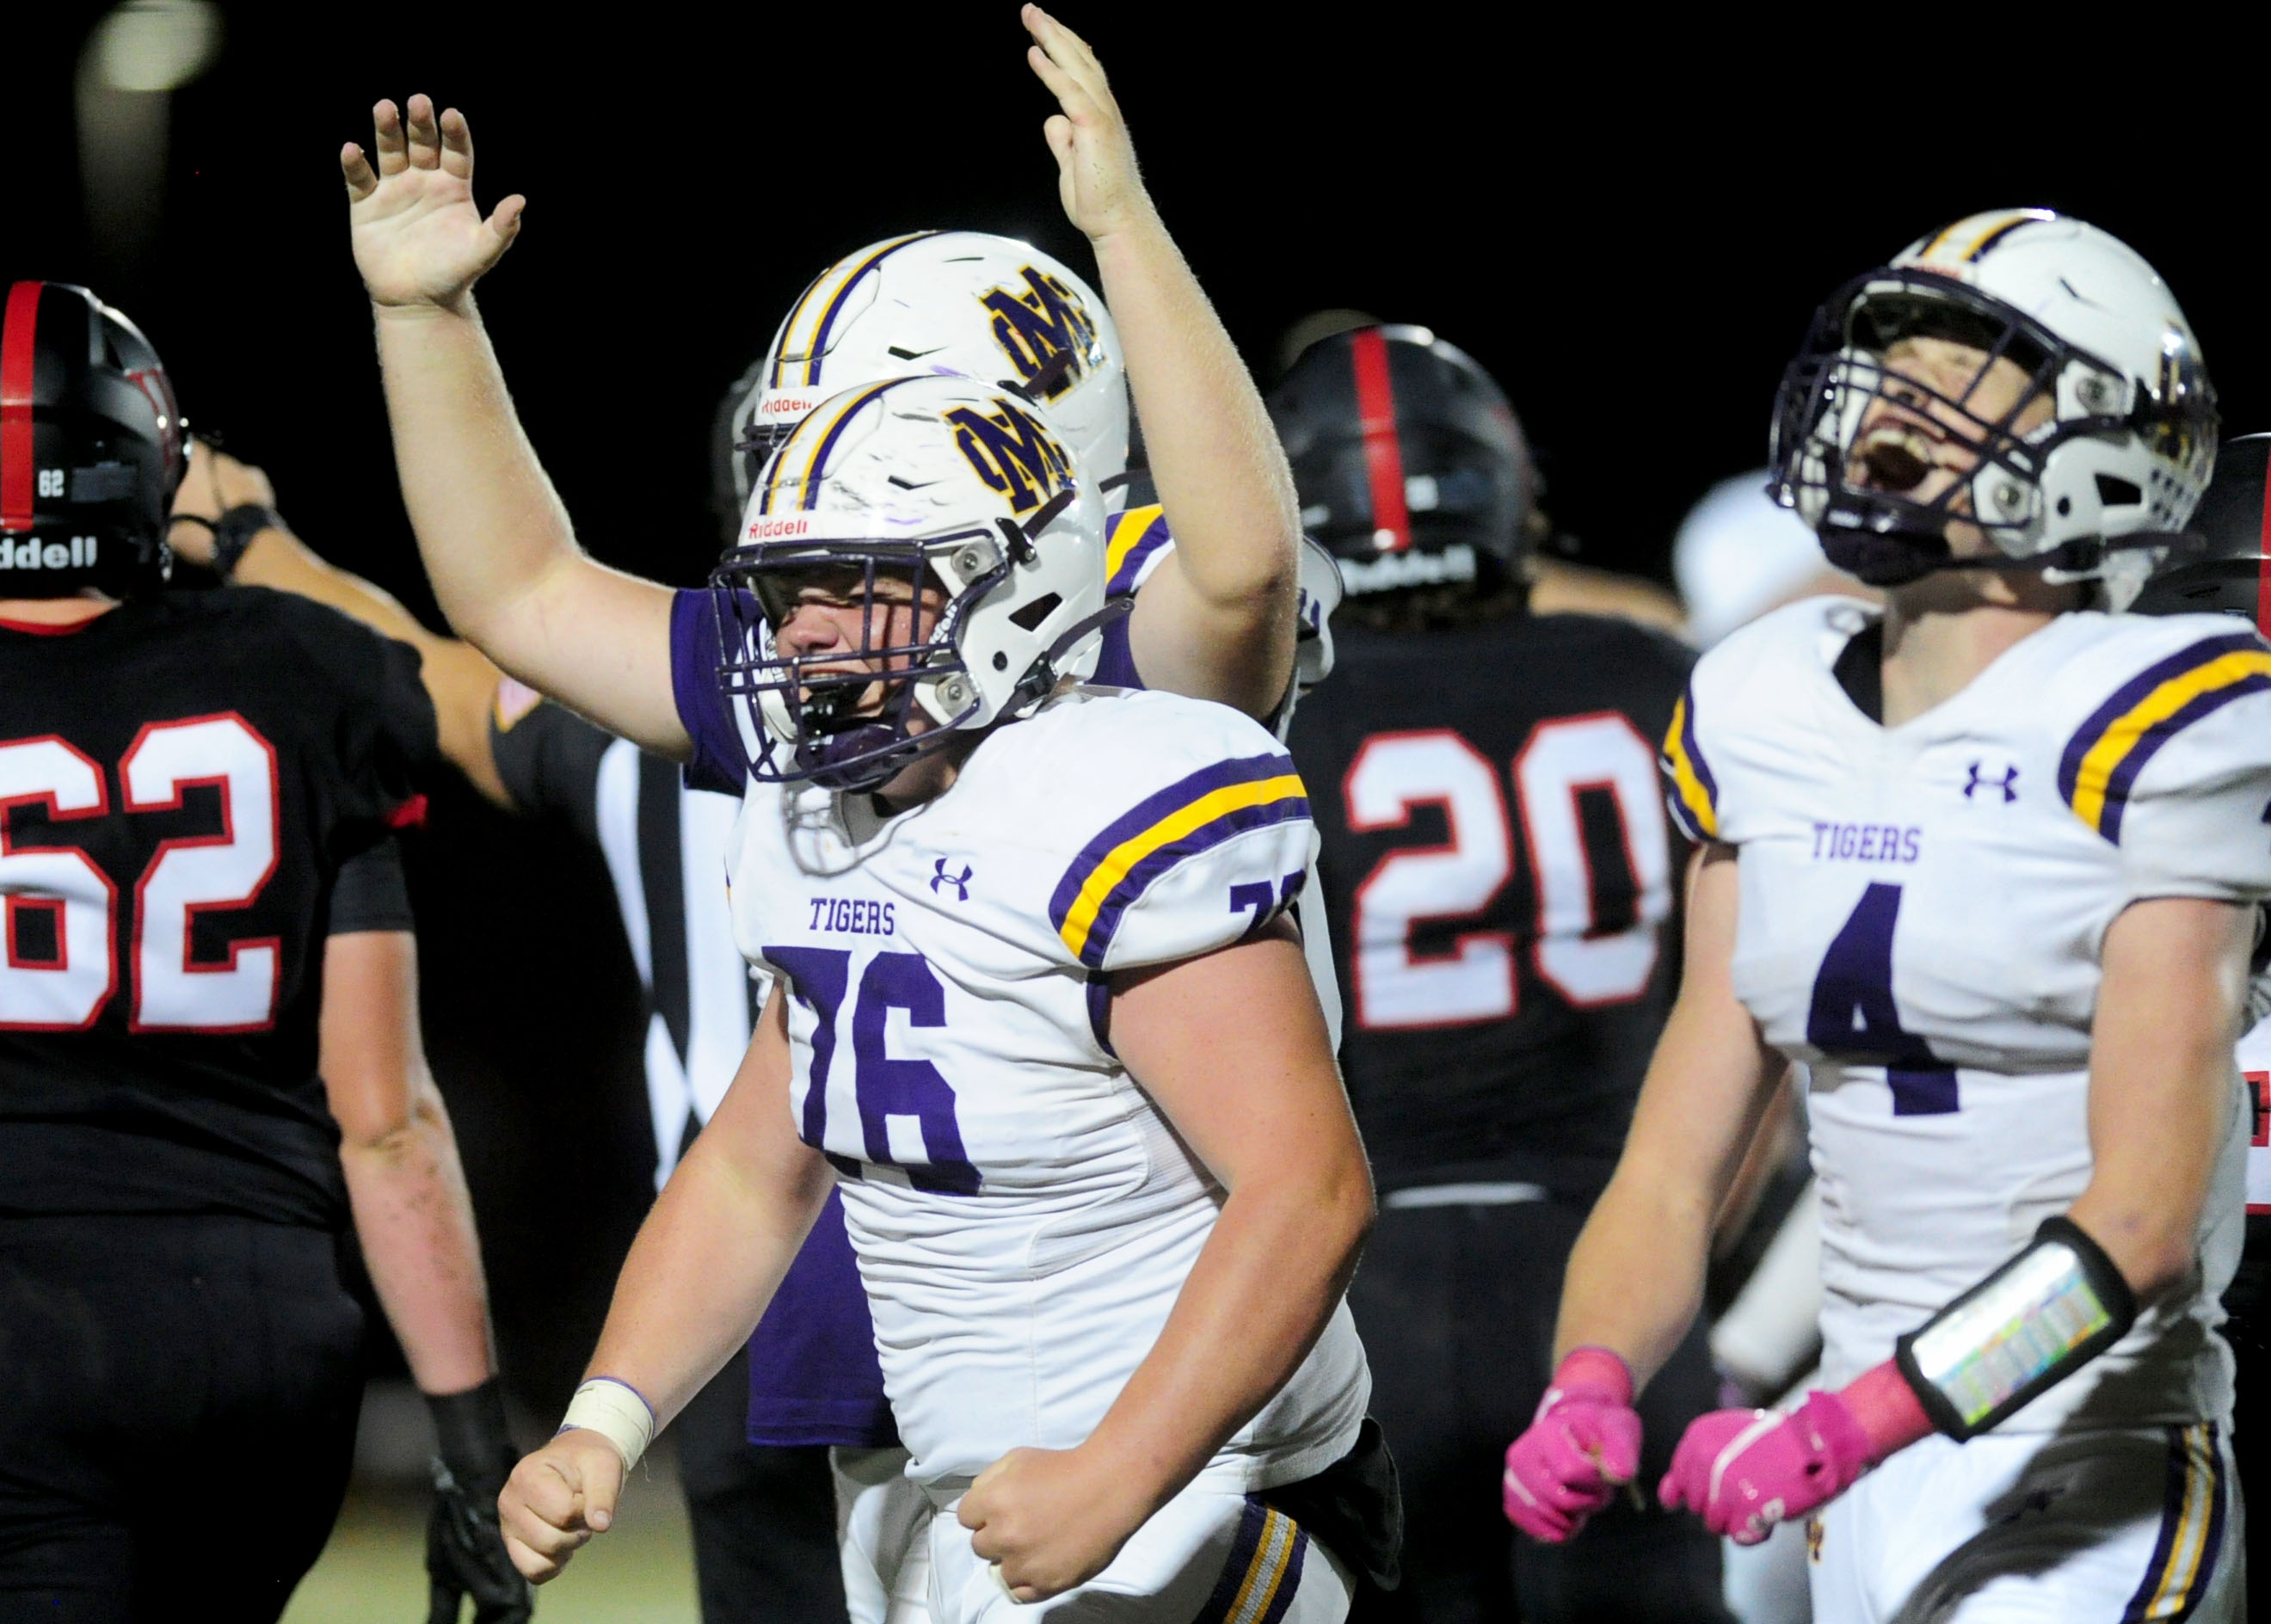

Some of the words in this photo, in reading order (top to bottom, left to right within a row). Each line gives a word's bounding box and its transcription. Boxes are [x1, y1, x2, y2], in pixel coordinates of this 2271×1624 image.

[749, 519, 808, 538] Riddell
[0, 710, 281, 1035] 62
[809, 898, 895, 937] TIGERS
[1343, 711, 1672, 1029] 20
[1812, 822, 1923, 862] TIGERS
[761, 945, 983, 1196] 76
[1807, 882, 1960, 1116] 4
